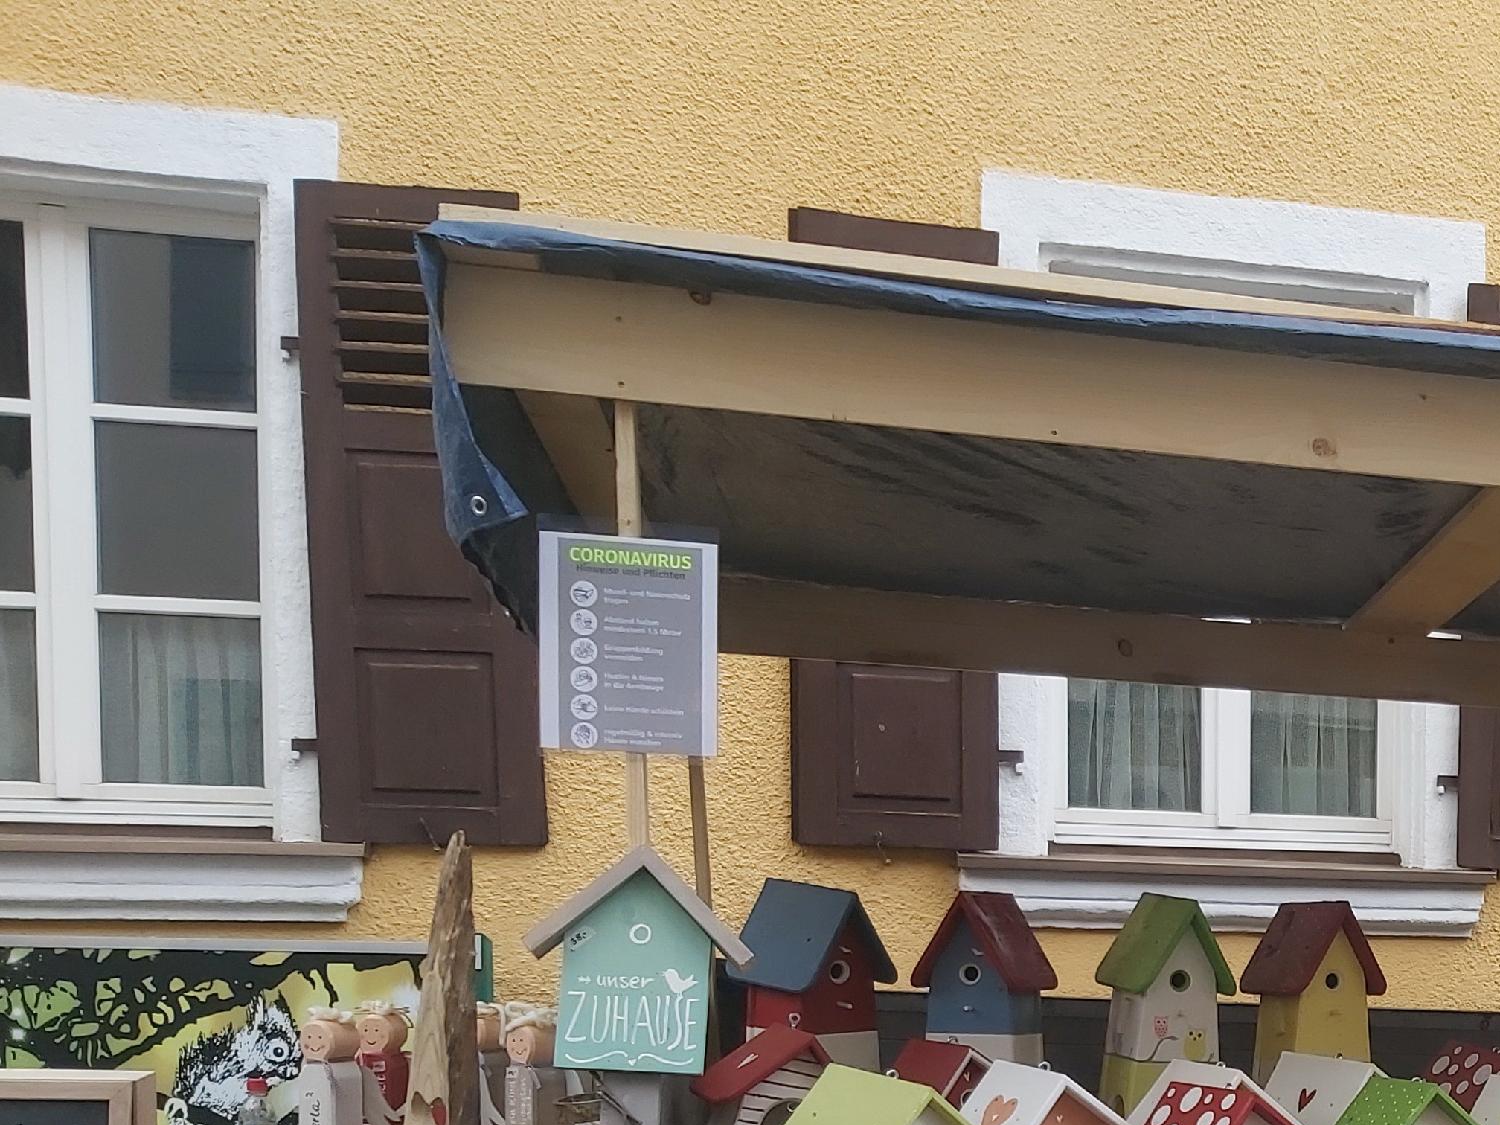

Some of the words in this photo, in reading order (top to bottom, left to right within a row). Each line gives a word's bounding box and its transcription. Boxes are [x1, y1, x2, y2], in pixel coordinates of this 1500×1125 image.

[569, 547, 692, 569] CORONAVIRUS
[596, 974, 656, 990] unser
[564, 990, 700, 1051] ZUHAUSE
